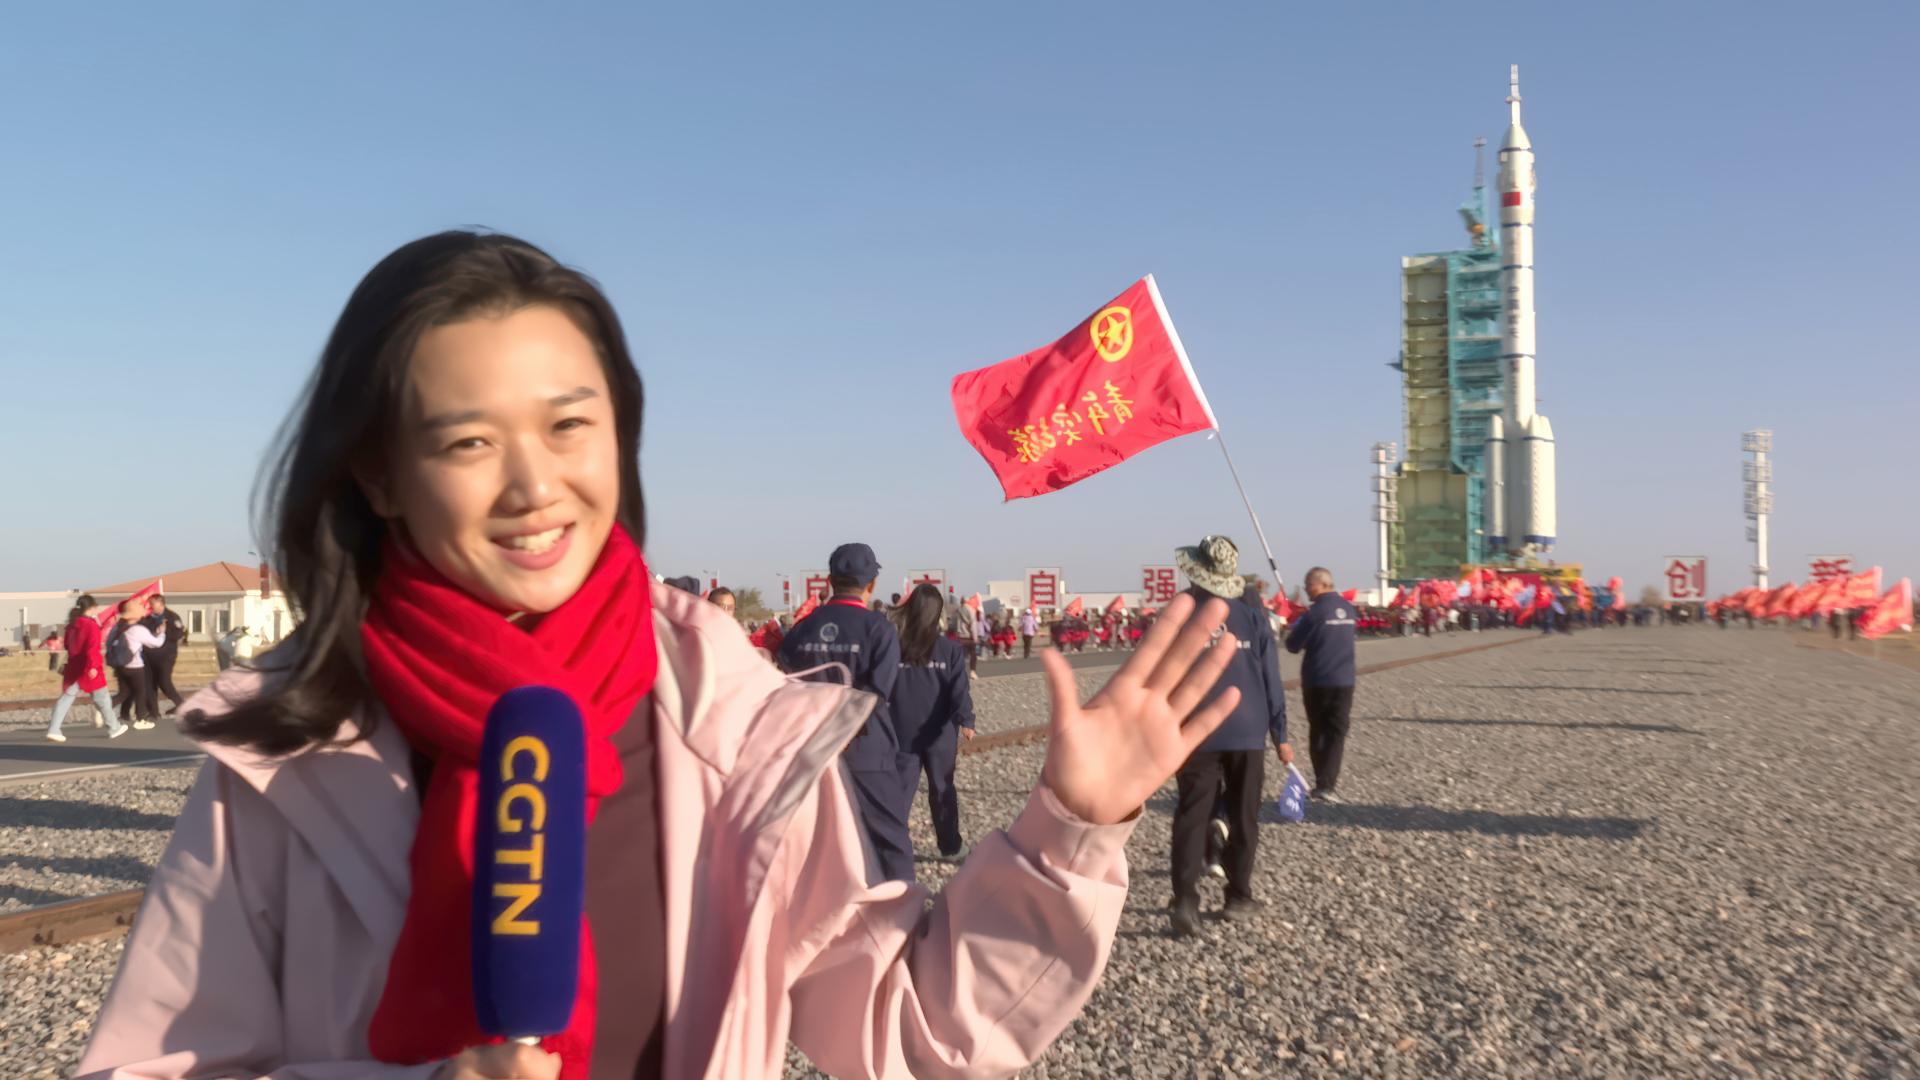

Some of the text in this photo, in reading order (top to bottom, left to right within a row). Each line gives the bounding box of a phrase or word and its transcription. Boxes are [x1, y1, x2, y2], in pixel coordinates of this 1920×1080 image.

[1029, 570, 1056, 605] 自
[1143, 568, 1177, 603] 强
[1664, 559, 1707, 599] 创
[491, 735, 550, 936] CGTN
